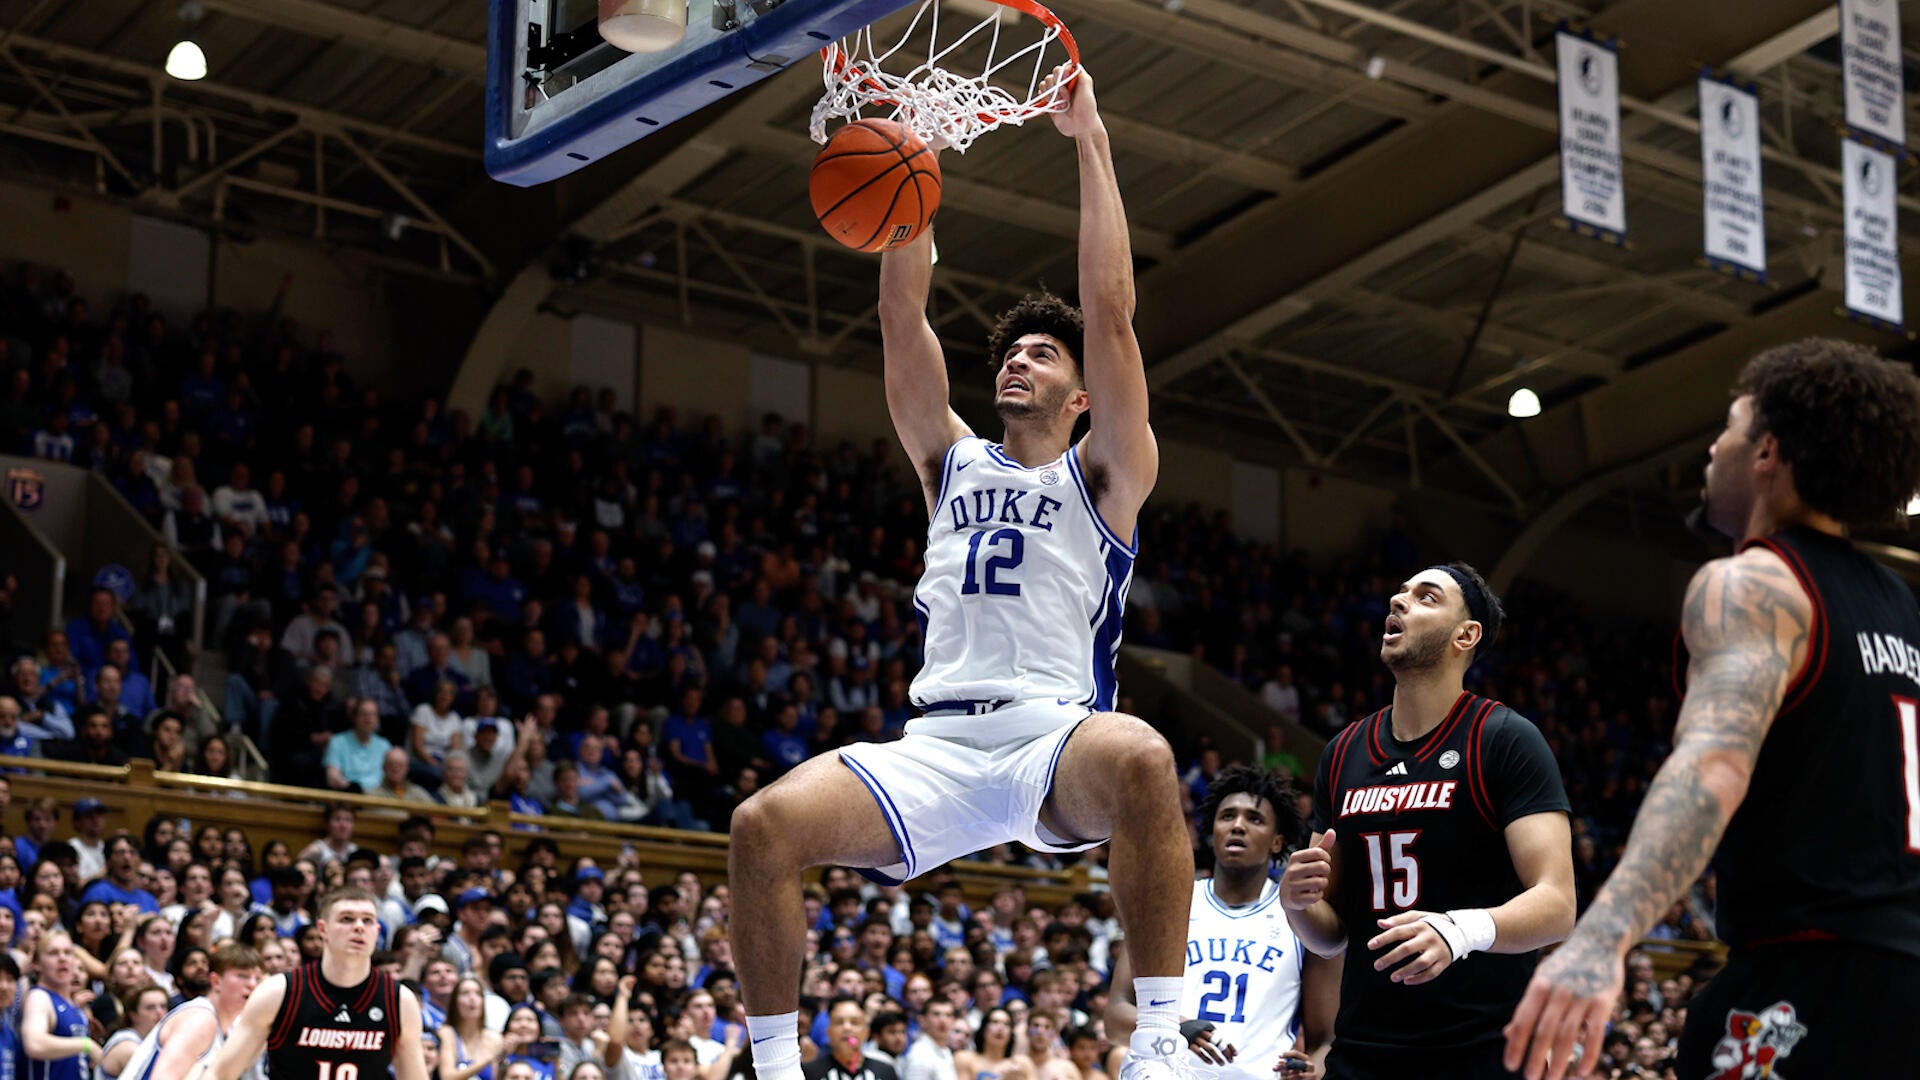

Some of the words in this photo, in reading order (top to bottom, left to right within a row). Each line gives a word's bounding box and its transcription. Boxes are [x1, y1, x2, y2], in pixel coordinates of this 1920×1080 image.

[950, 488, 1063, 532] DUKE
[961, 528, 1024, 597] 12
[1338, 779, 1459, 819] LOUISVILLE
[1359, 829, 1424, 912] 15
[1187, 938, 1284, 973] DUKE
[1197, 970, 1249, 1023] 21
[297, 1027, 386, 1052] LOUISVILLE
